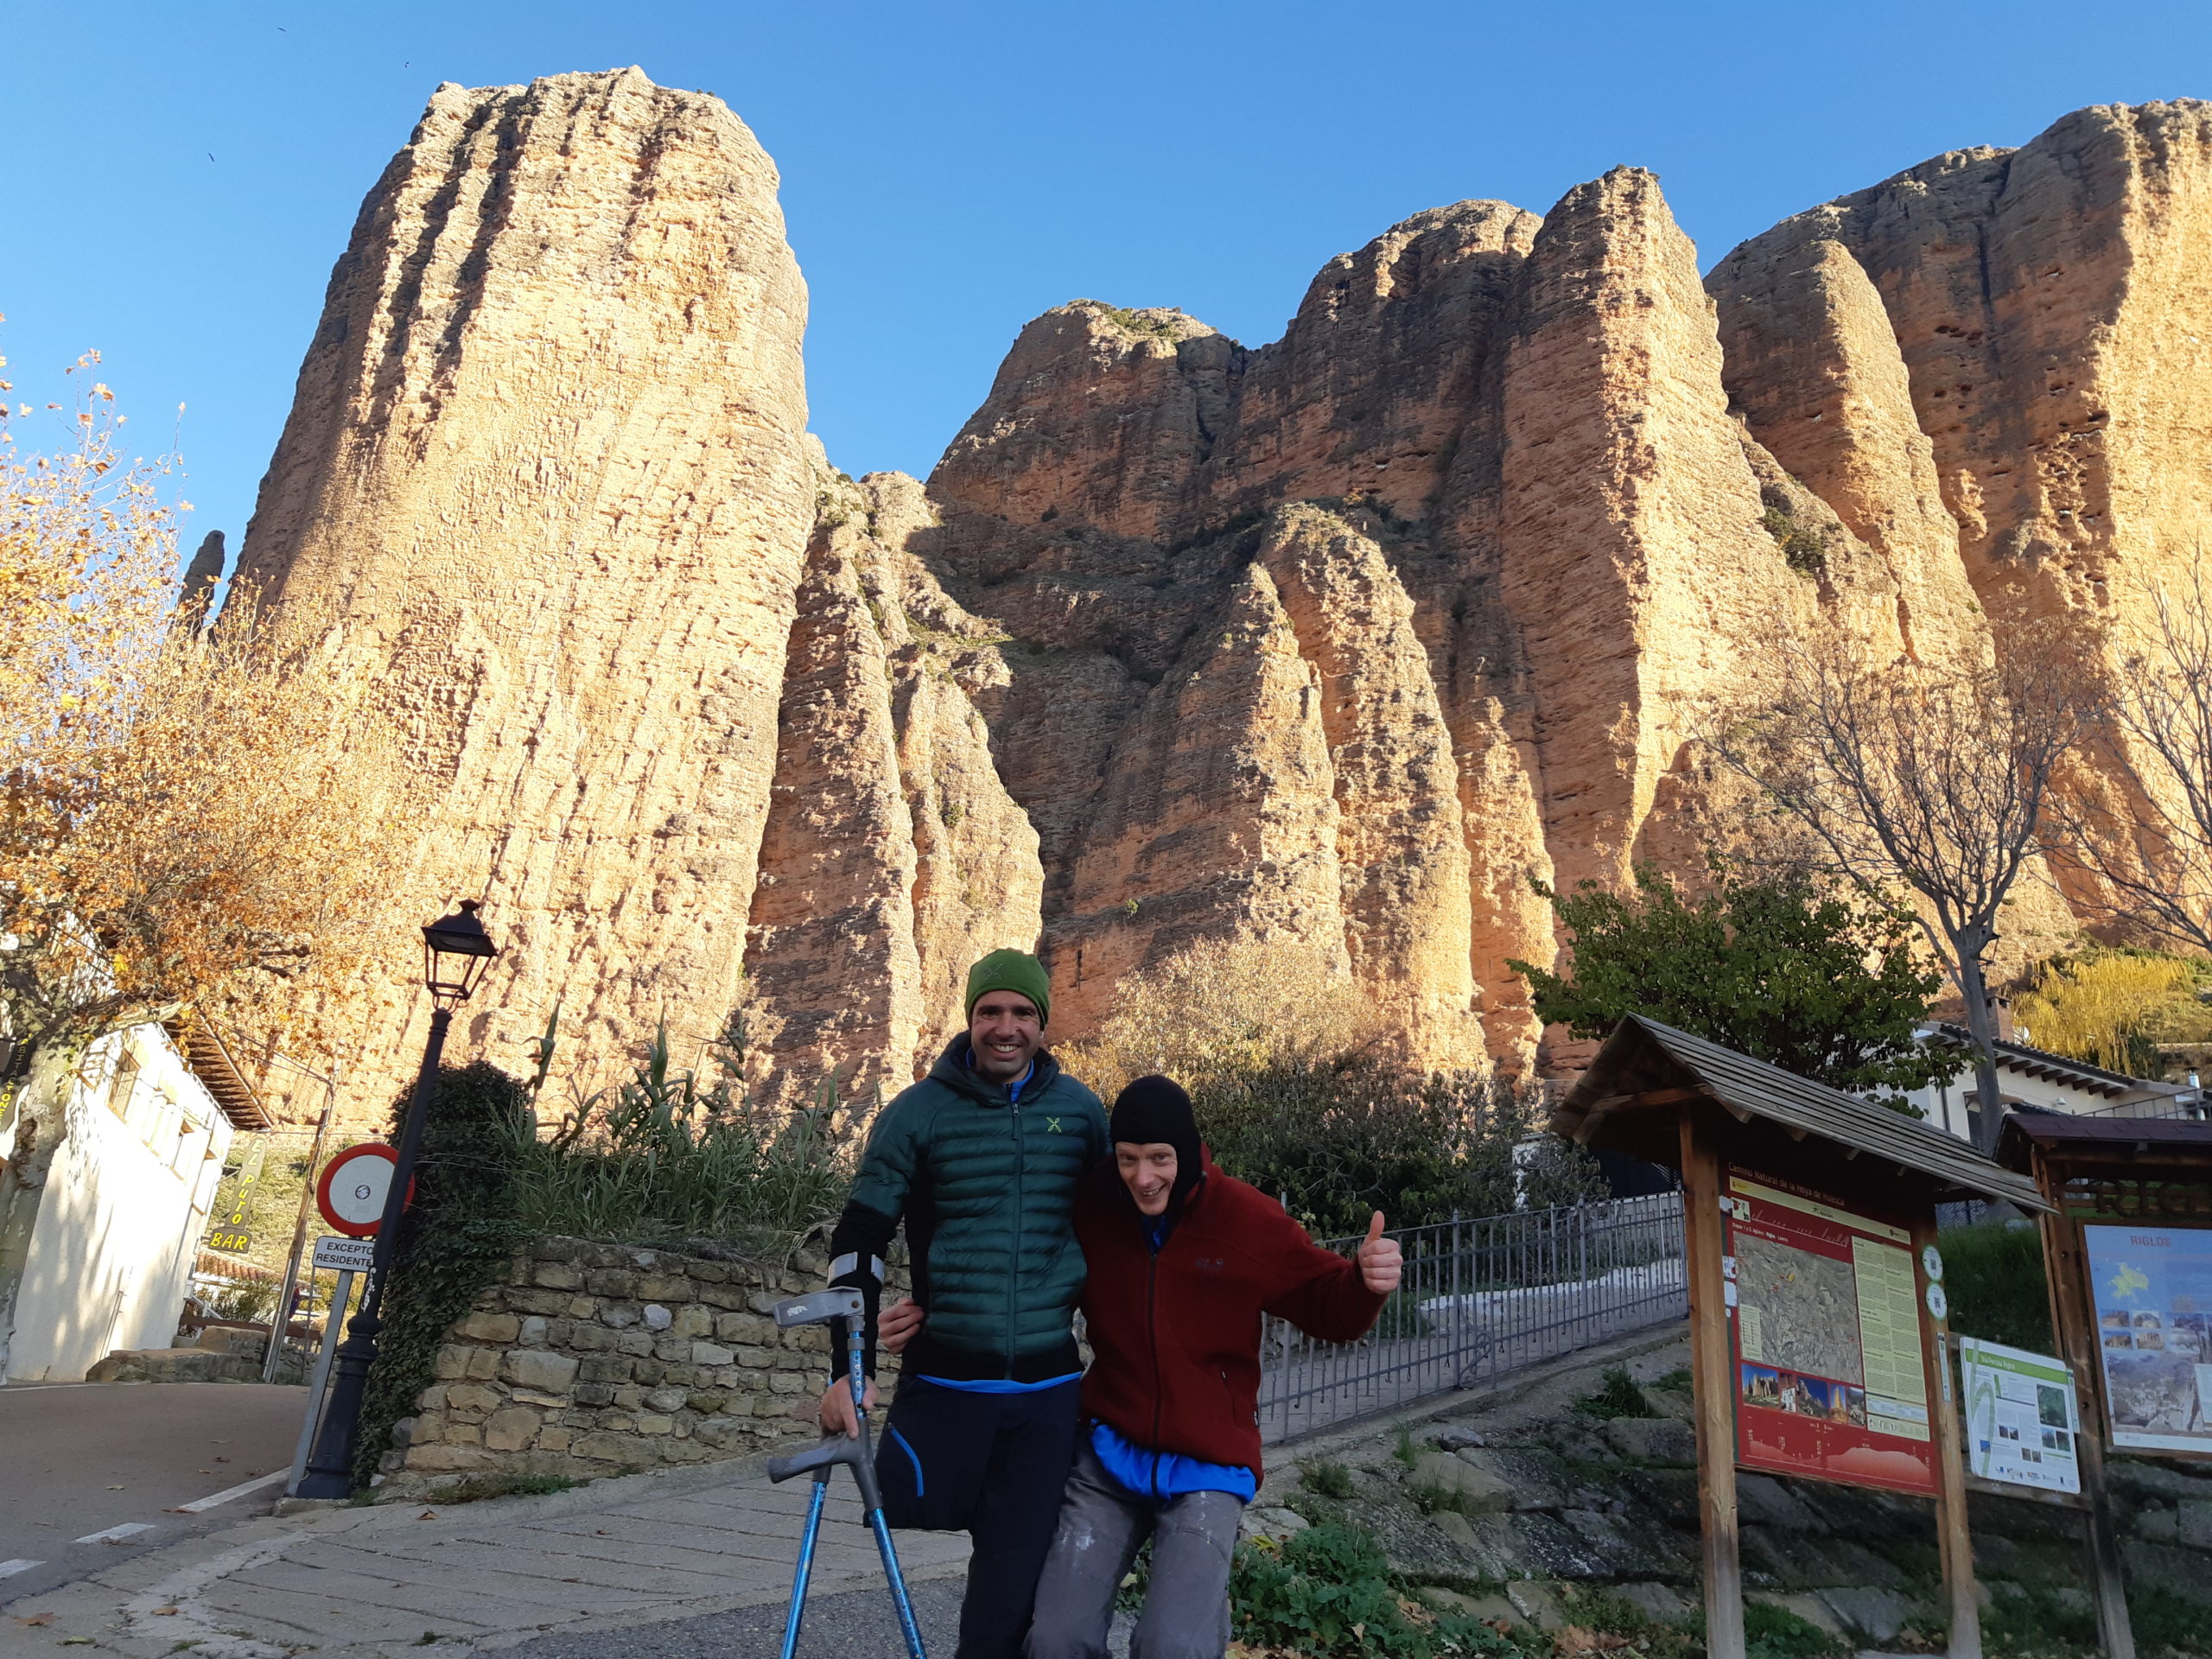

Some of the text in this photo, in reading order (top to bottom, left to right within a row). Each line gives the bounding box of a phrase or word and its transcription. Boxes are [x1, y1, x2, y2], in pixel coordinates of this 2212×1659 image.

[248, 1139, 264, 1166] EL
[1728, 1161, 1846, 1206] Camino Natural de la Hoya de Huesca
[210, 1232, 248, 1250] BAR
[327, 1242, 374, 1255] EXCEPTO
[2131, 1236, 2171, 1247] RIGLOS
[315, 1253, 372, 1267] RESIDENTE
